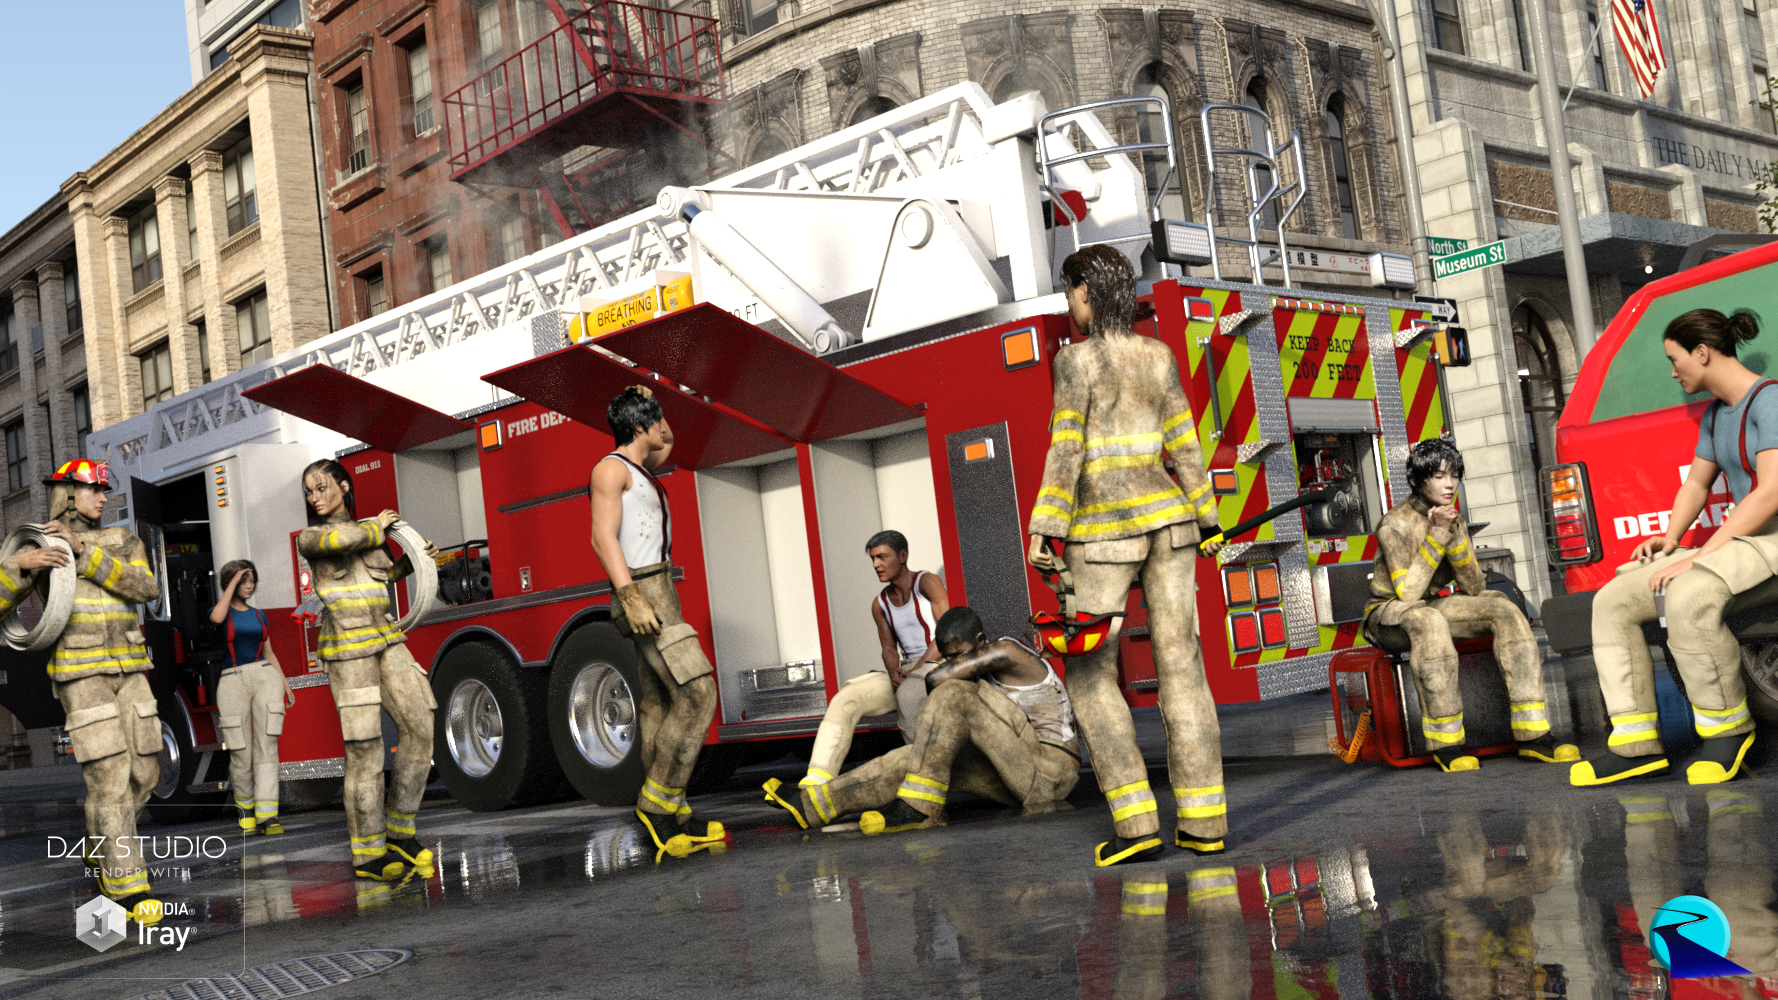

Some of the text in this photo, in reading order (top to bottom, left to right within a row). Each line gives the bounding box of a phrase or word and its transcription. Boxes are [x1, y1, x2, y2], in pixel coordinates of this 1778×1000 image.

[1653, 136, 1689, 166] THE
[1692, 145, 1742, 178] DAILY
[1428, 239, 1467, 255] North St
[1436, 245, 1503, 276] Museum St
[597, 295, 653, 327] BREATHING
[745, 302, 758, 320] FT
[1437, 305, 1451, 316] WAY
[1288, 334, 1357, 354] KEEP BACK
[1293, 361, 1361, 382] 200 FEET
[507, 415, 539, 439] FIRE
[355, 460, 381, 474] DIAL 911
